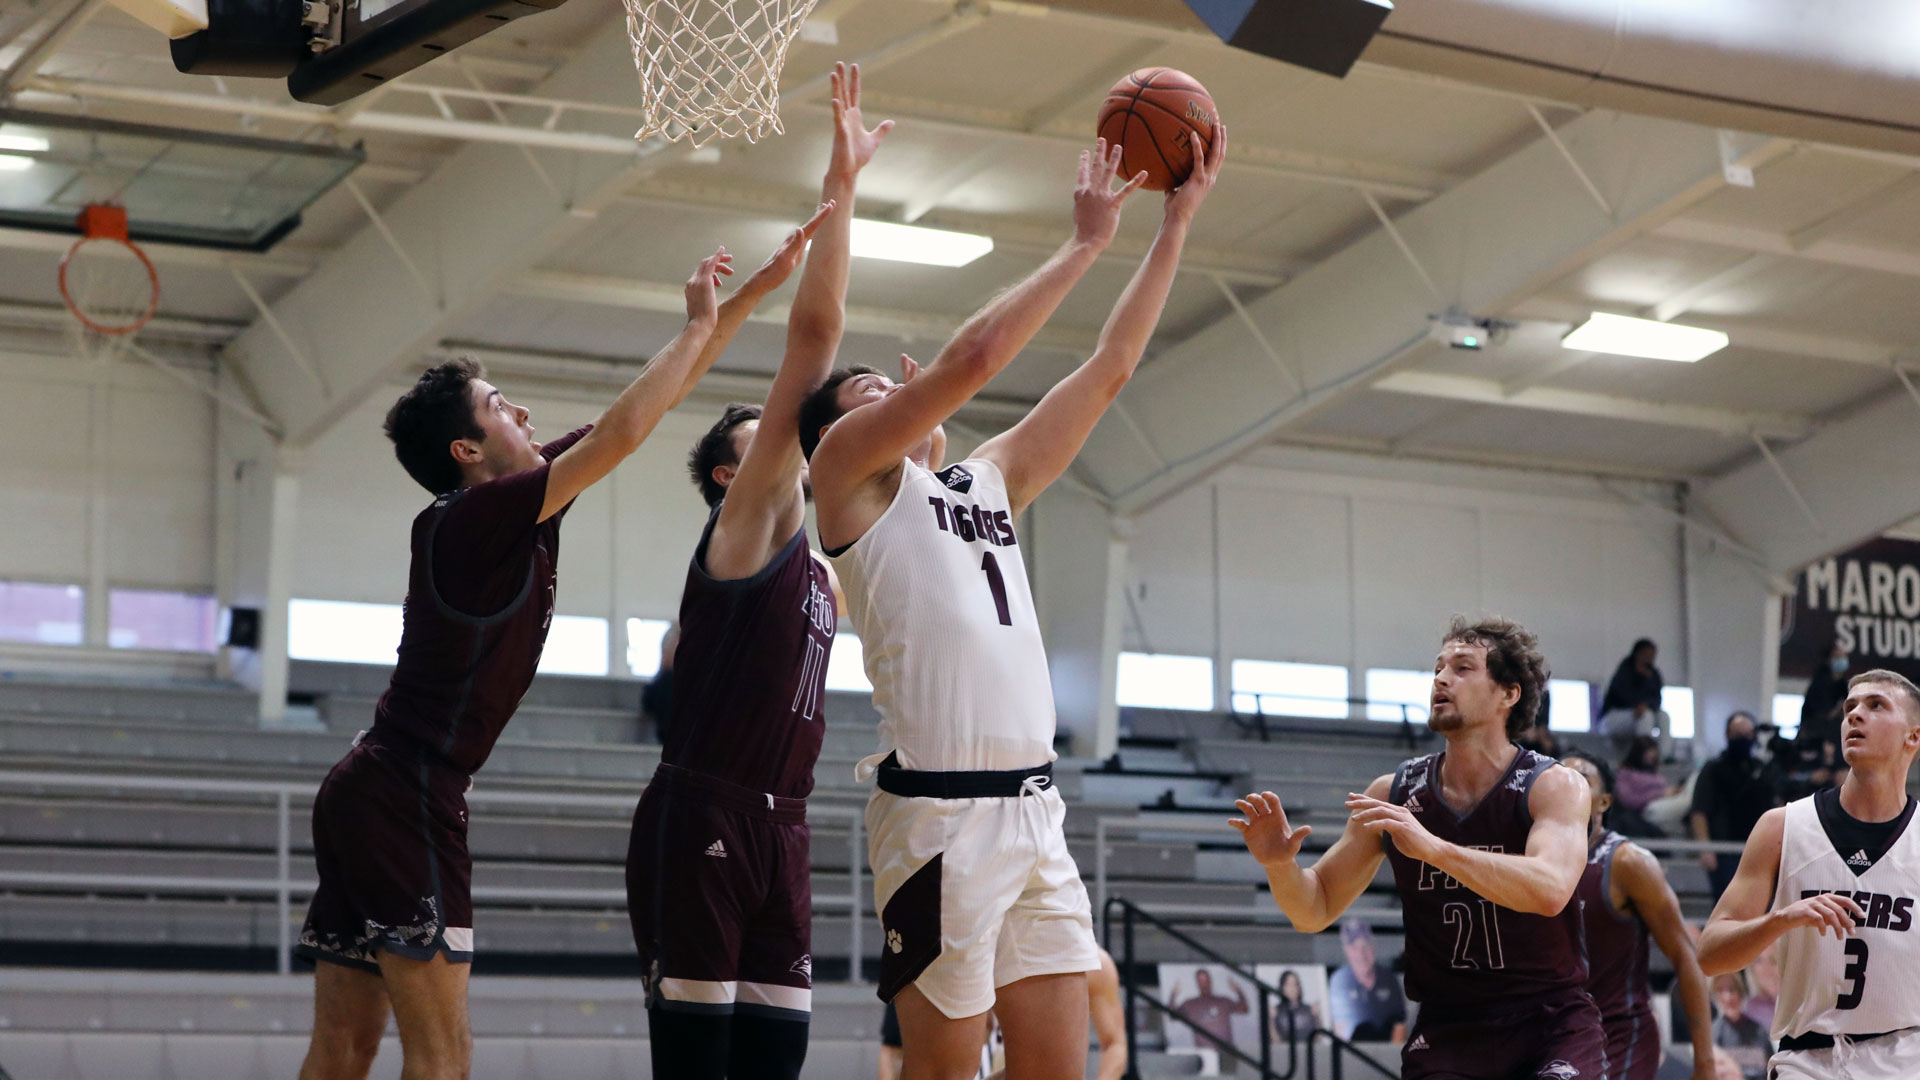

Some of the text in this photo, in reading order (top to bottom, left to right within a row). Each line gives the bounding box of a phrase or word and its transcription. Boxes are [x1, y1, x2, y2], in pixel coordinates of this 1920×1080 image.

[947, 474, 972, 487] adidas
[981, 551, 1012, 626] 1
[791, 634, 824, 720] 11
[1444, 900, 1504, 969] 21
[1836, 938, 1868, 1010] 3
